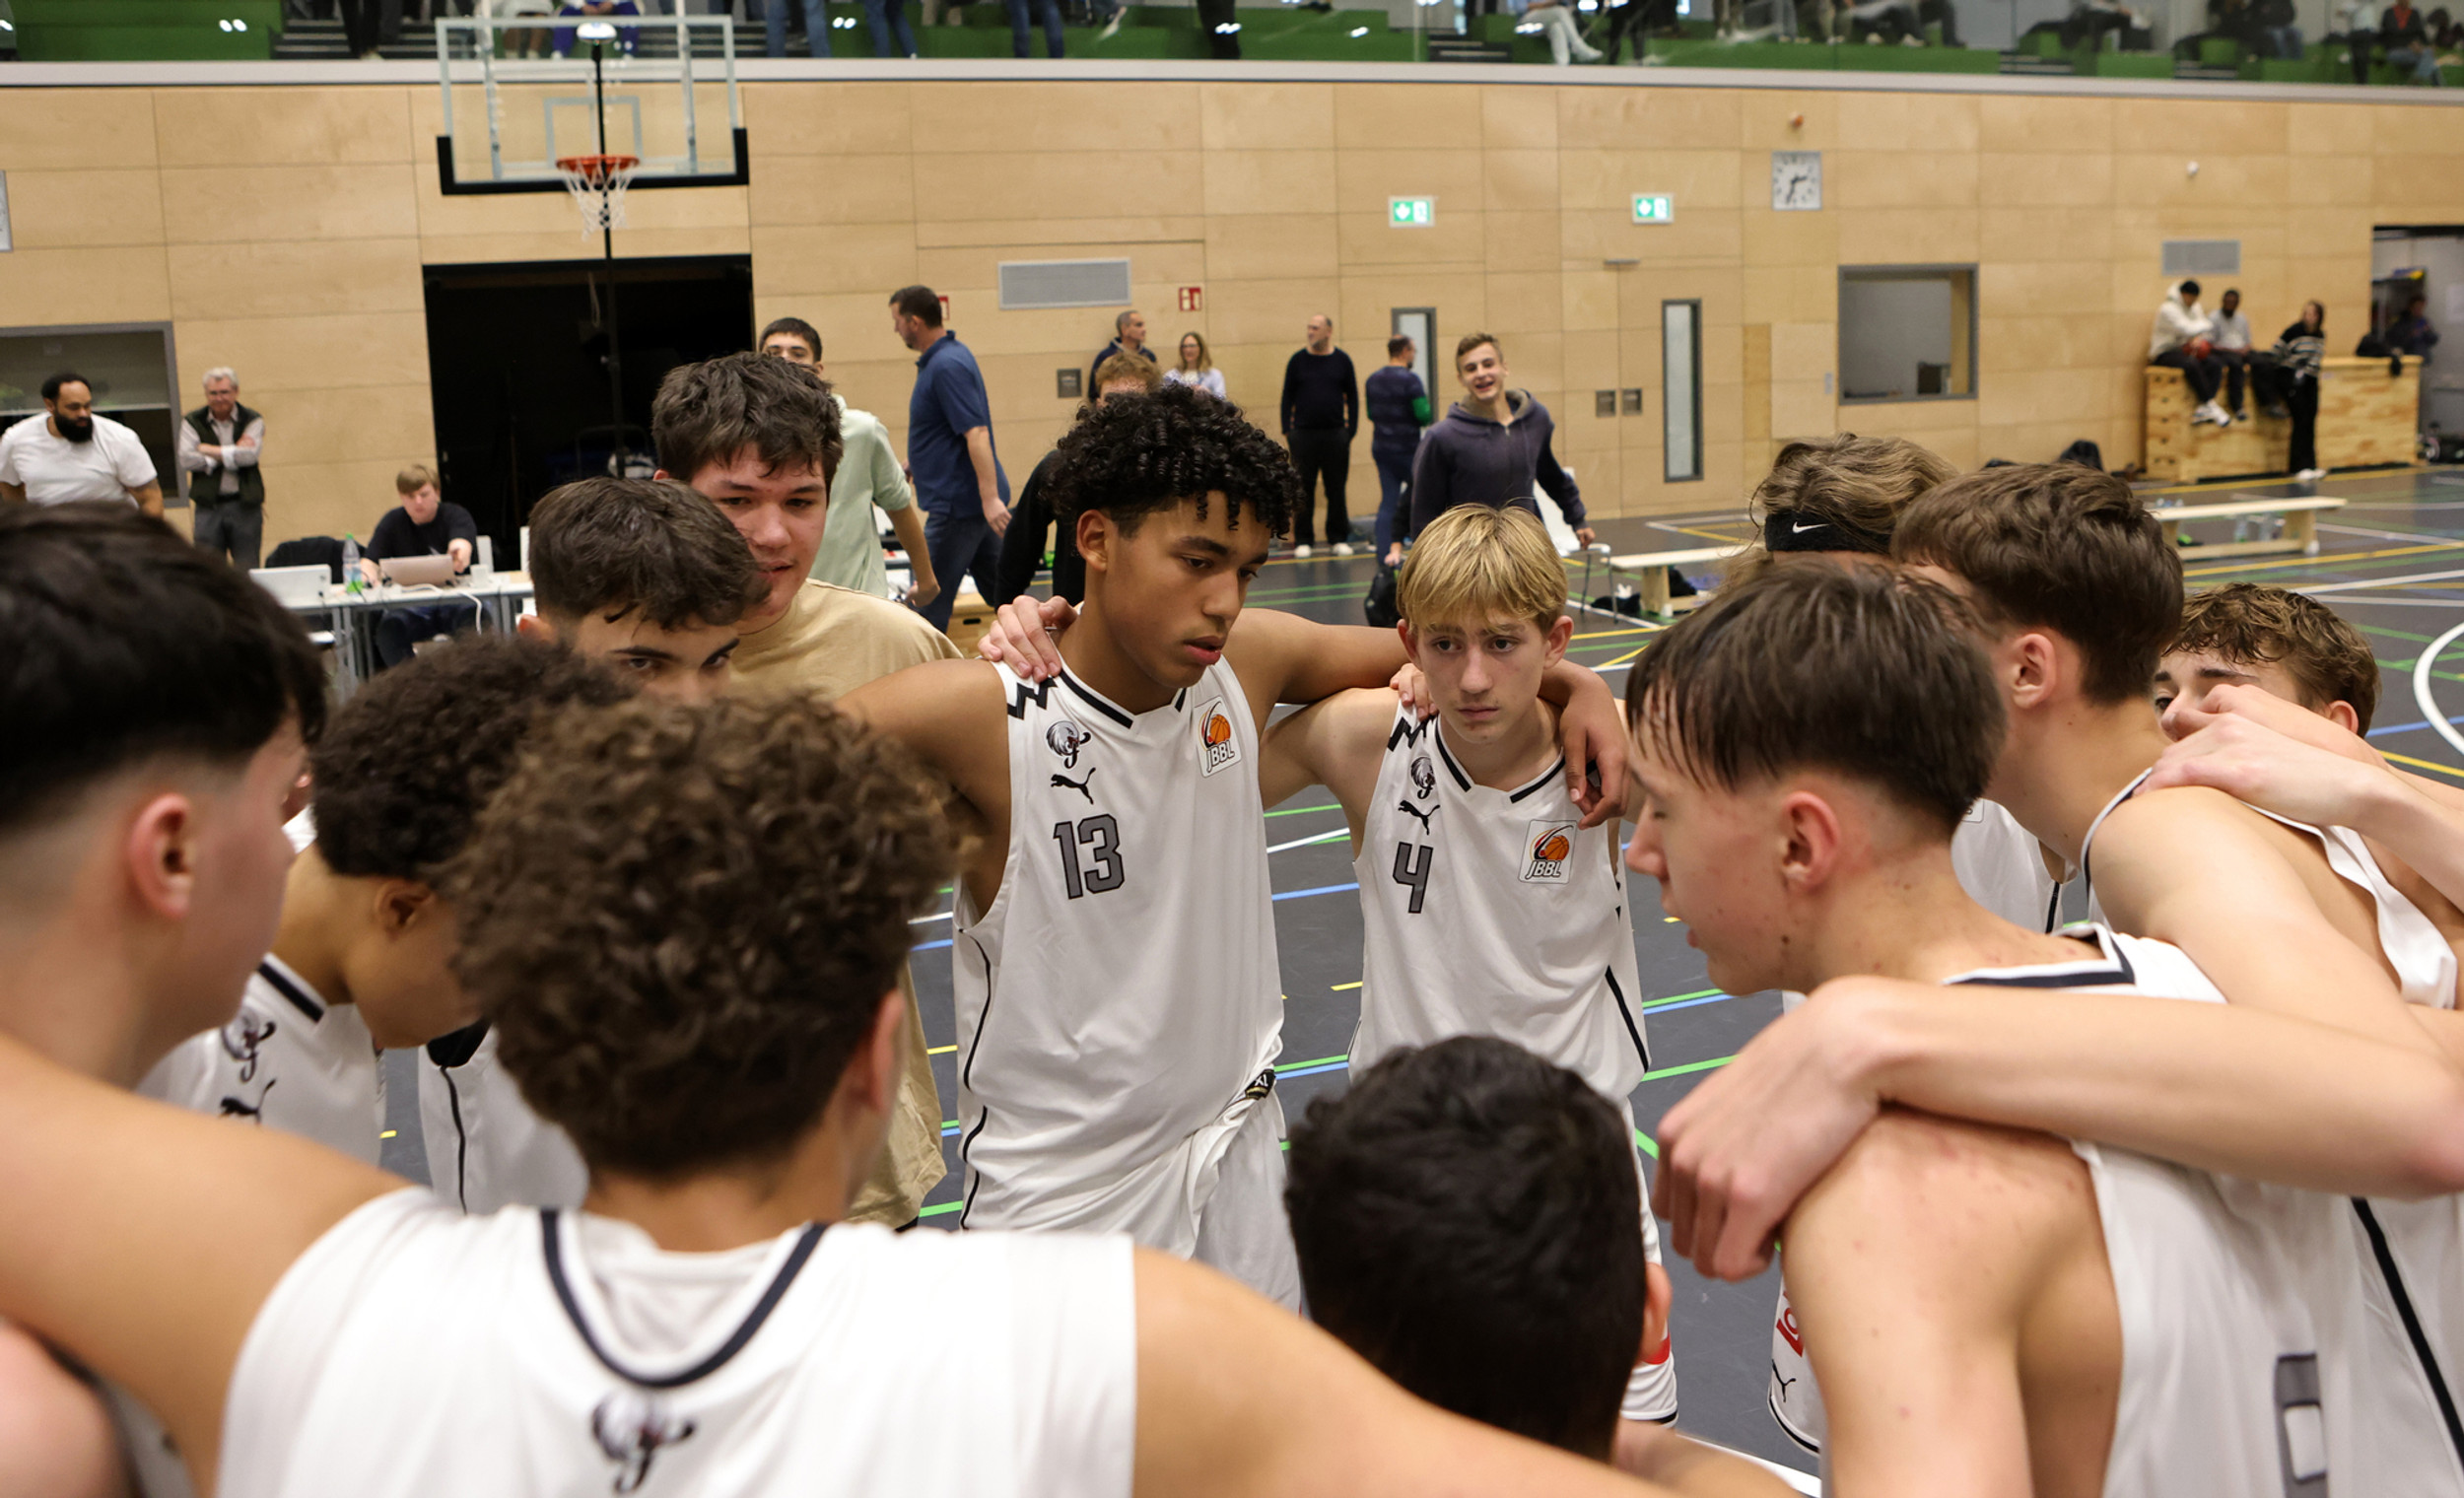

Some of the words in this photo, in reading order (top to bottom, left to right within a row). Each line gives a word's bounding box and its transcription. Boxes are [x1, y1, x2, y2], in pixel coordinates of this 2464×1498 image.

[1206, 740, 1235, 773] JBBL
[1053, 813, 1125, 900] 13
[1392, 841, 1434, 914] 4
[1525, 859, 1561, 880] JBBL
